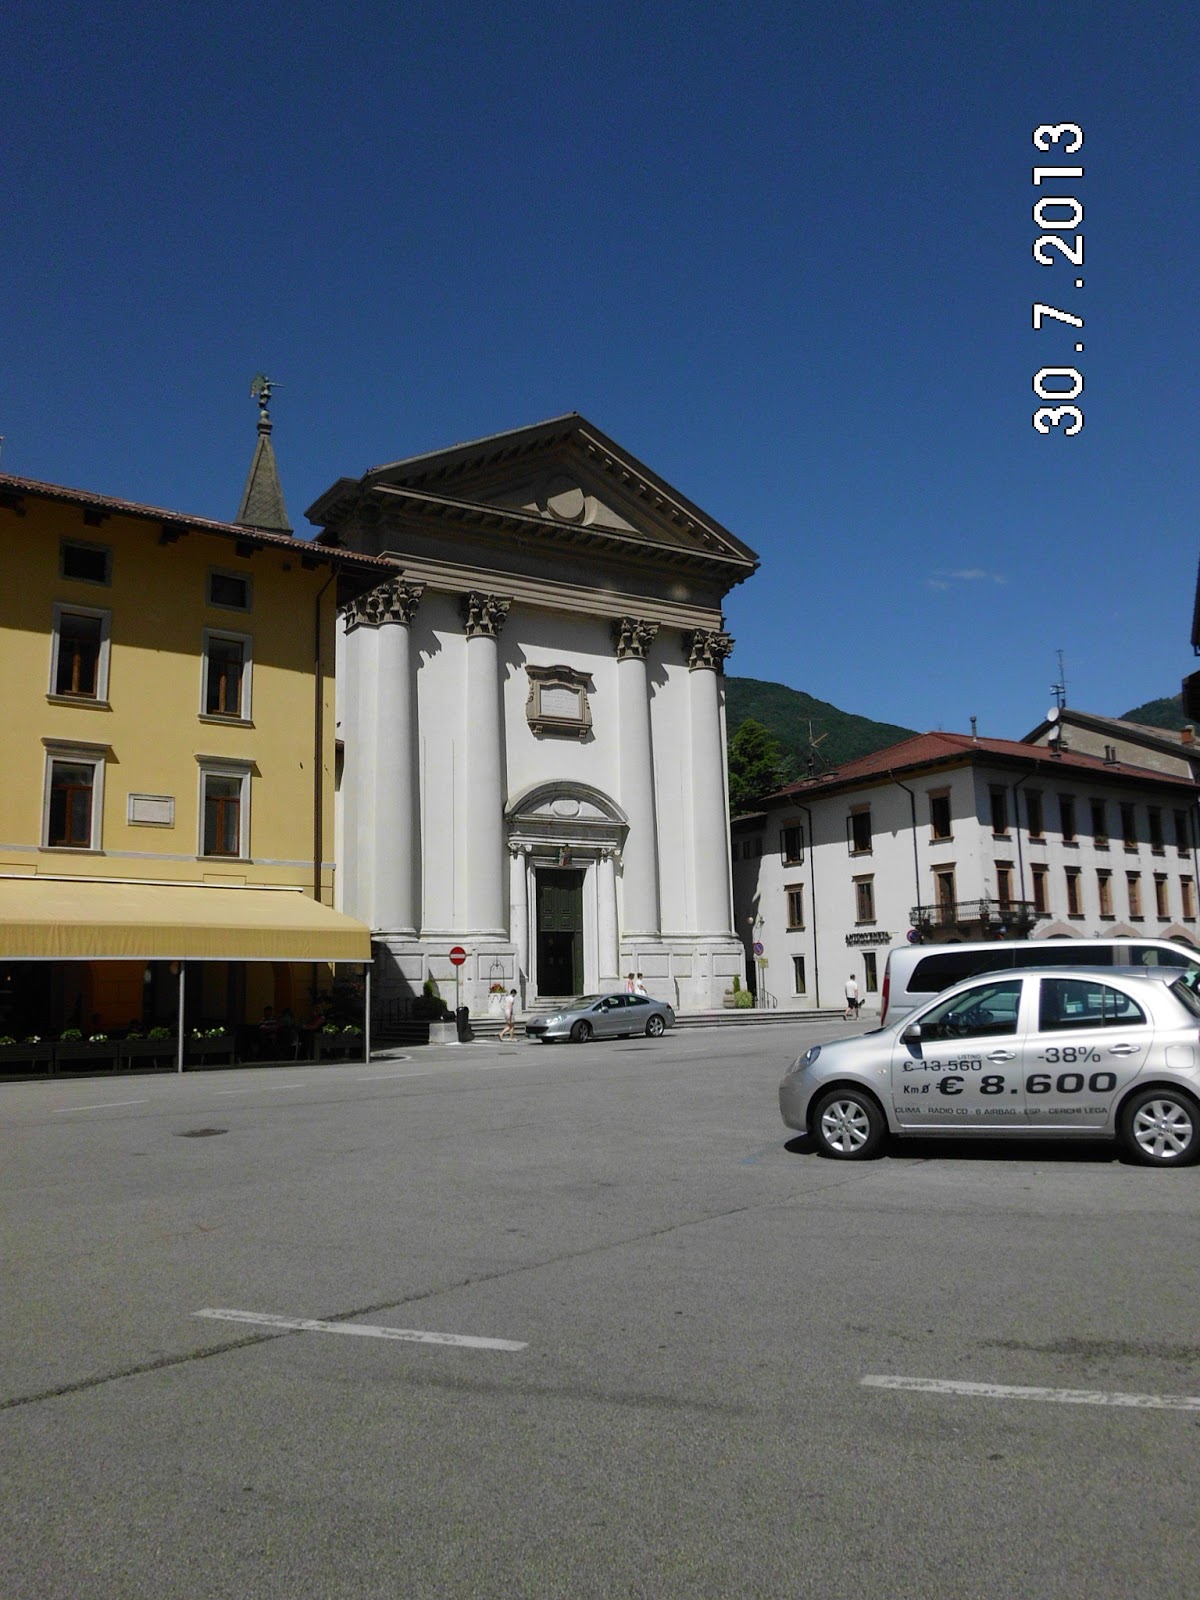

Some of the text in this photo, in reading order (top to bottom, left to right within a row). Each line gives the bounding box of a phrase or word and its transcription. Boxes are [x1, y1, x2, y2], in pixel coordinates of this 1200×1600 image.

[1037, 1046, 1101, 1063] -38%
[903, 1060, 983, 1072] € 13.560
[903, 1085, 919, 1094] Km
[935, 1072, 1118, 1096] € 8.600
[928, 1107, 954, 1115] RADIO
[984, 1108, 1017, 1116] AIRBAG
[1048, 1107, 1082, 1115] CERCHI
